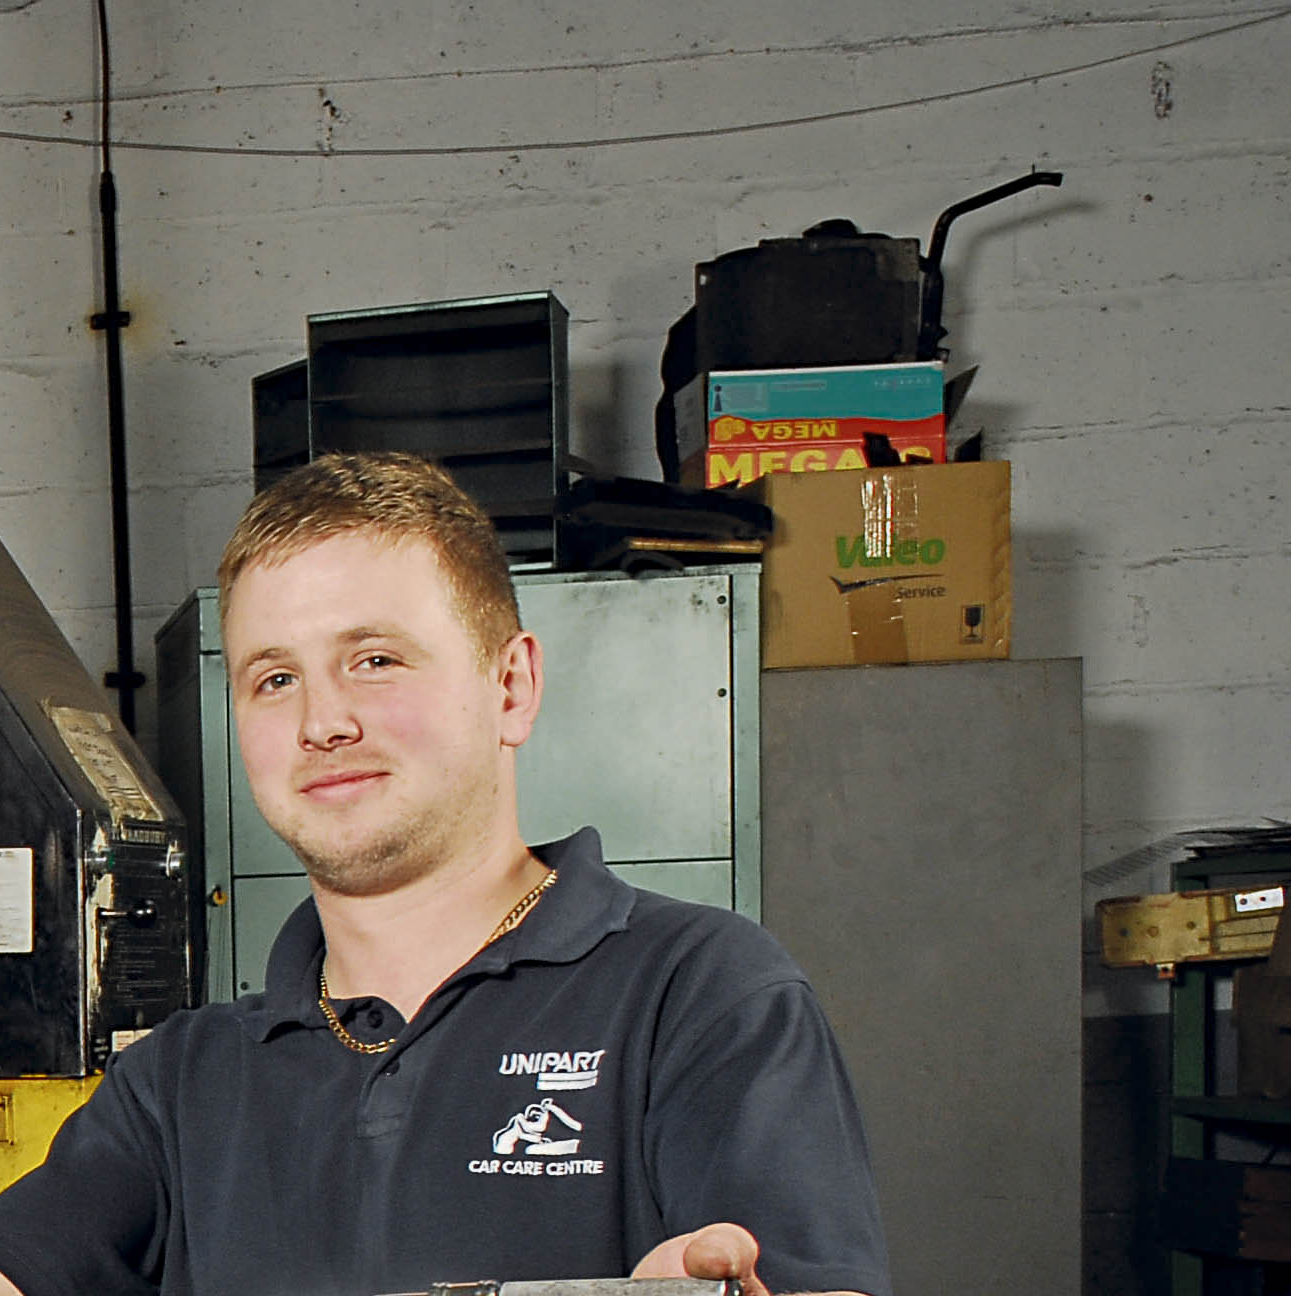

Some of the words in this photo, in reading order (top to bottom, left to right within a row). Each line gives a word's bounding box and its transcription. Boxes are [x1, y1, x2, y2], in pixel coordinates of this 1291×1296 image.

[752, 421, 836, 440] MEGA
[895, 585, 946, 599] Service
[499, 1050, 606, 1075] UNIPART
[468, 1160, 500, 1174] CAR
[502, 1161, 543, 1176] CARE
[546, 1160, 604, 1176] CENTRE
